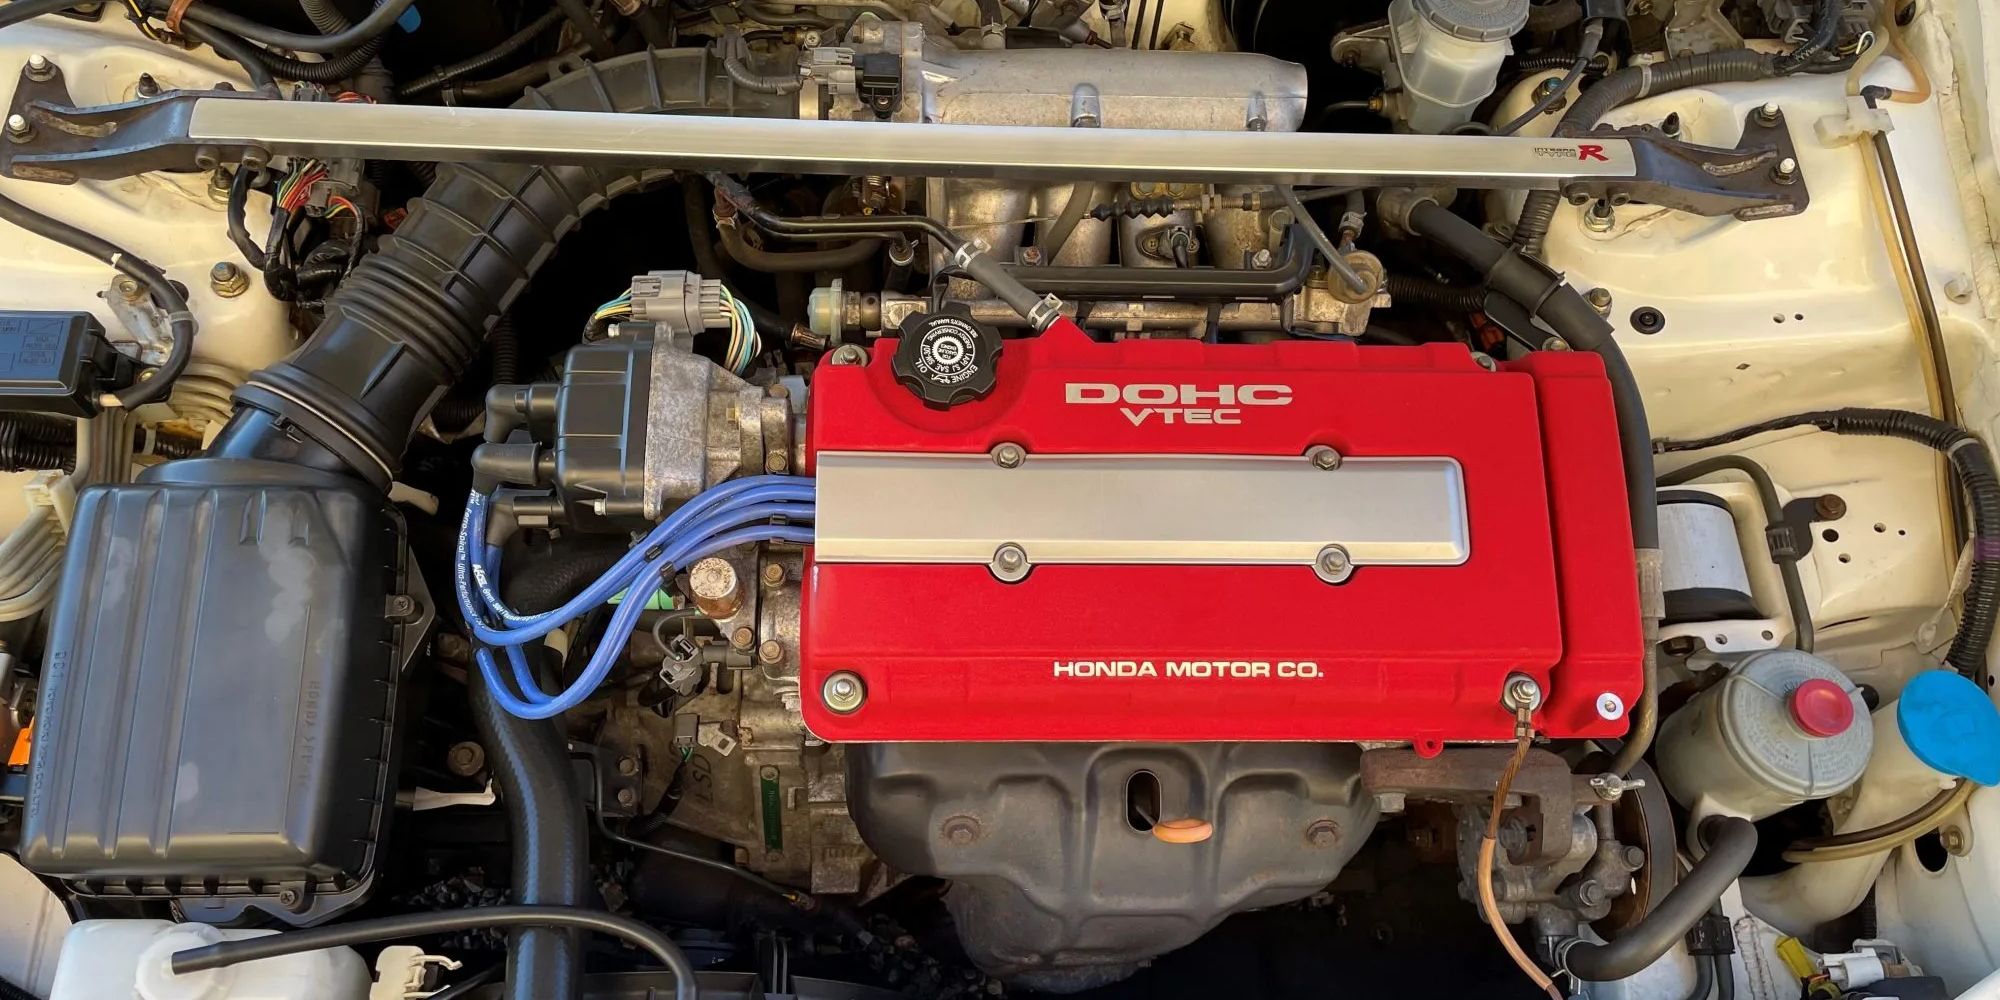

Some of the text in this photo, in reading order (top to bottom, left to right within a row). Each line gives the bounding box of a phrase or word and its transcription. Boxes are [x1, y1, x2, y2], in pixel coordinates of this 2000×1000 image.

[1578, 144, 1609, 161] R
[915, 357, 979, 383] ENGINE OIL
[935, 363, 950, 373] SAE
[1065, 383, 1293, 405] DOHC
[1119, 407, 1242, 427] VTEC
[1053, 661, 1324, 677] HONDA MOTOR CO.
